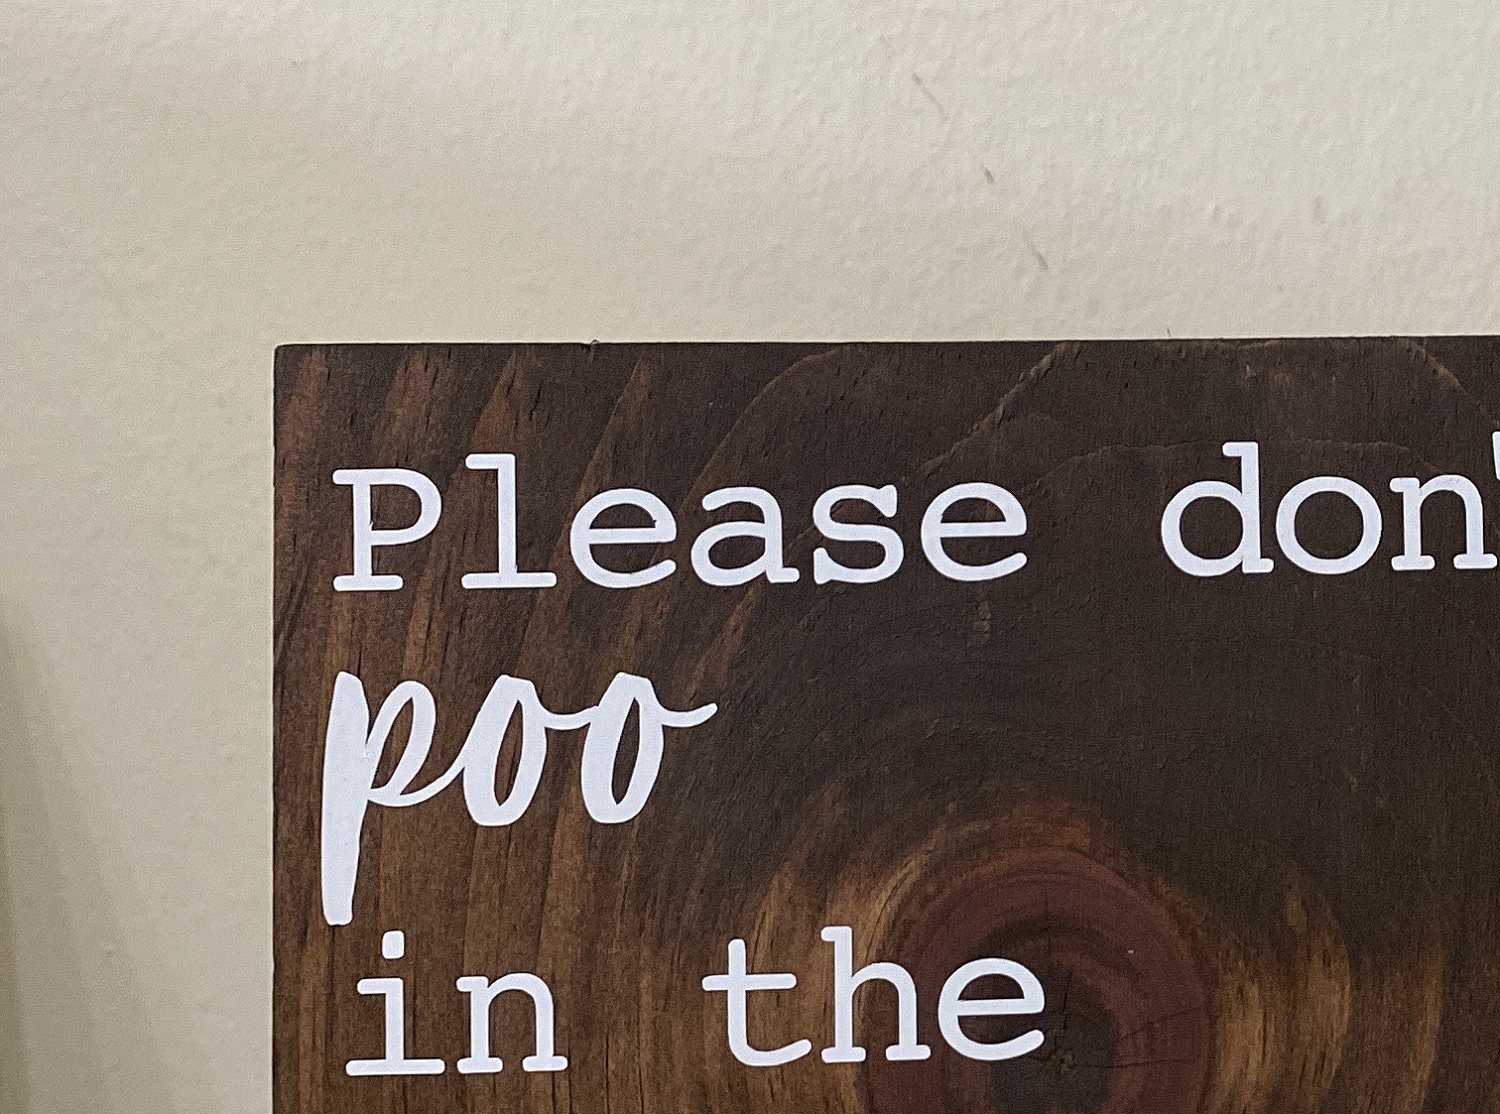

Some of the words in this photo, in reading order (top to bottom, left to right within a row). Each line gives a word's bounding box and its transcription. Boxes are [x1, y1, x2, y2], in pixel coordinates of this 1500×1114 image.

[332, 453, 1029, 592] Please
[320, 670, 718, 926] poo
[345, 930, 568, 1076] in
[701, 925, 1046, 1067] the
